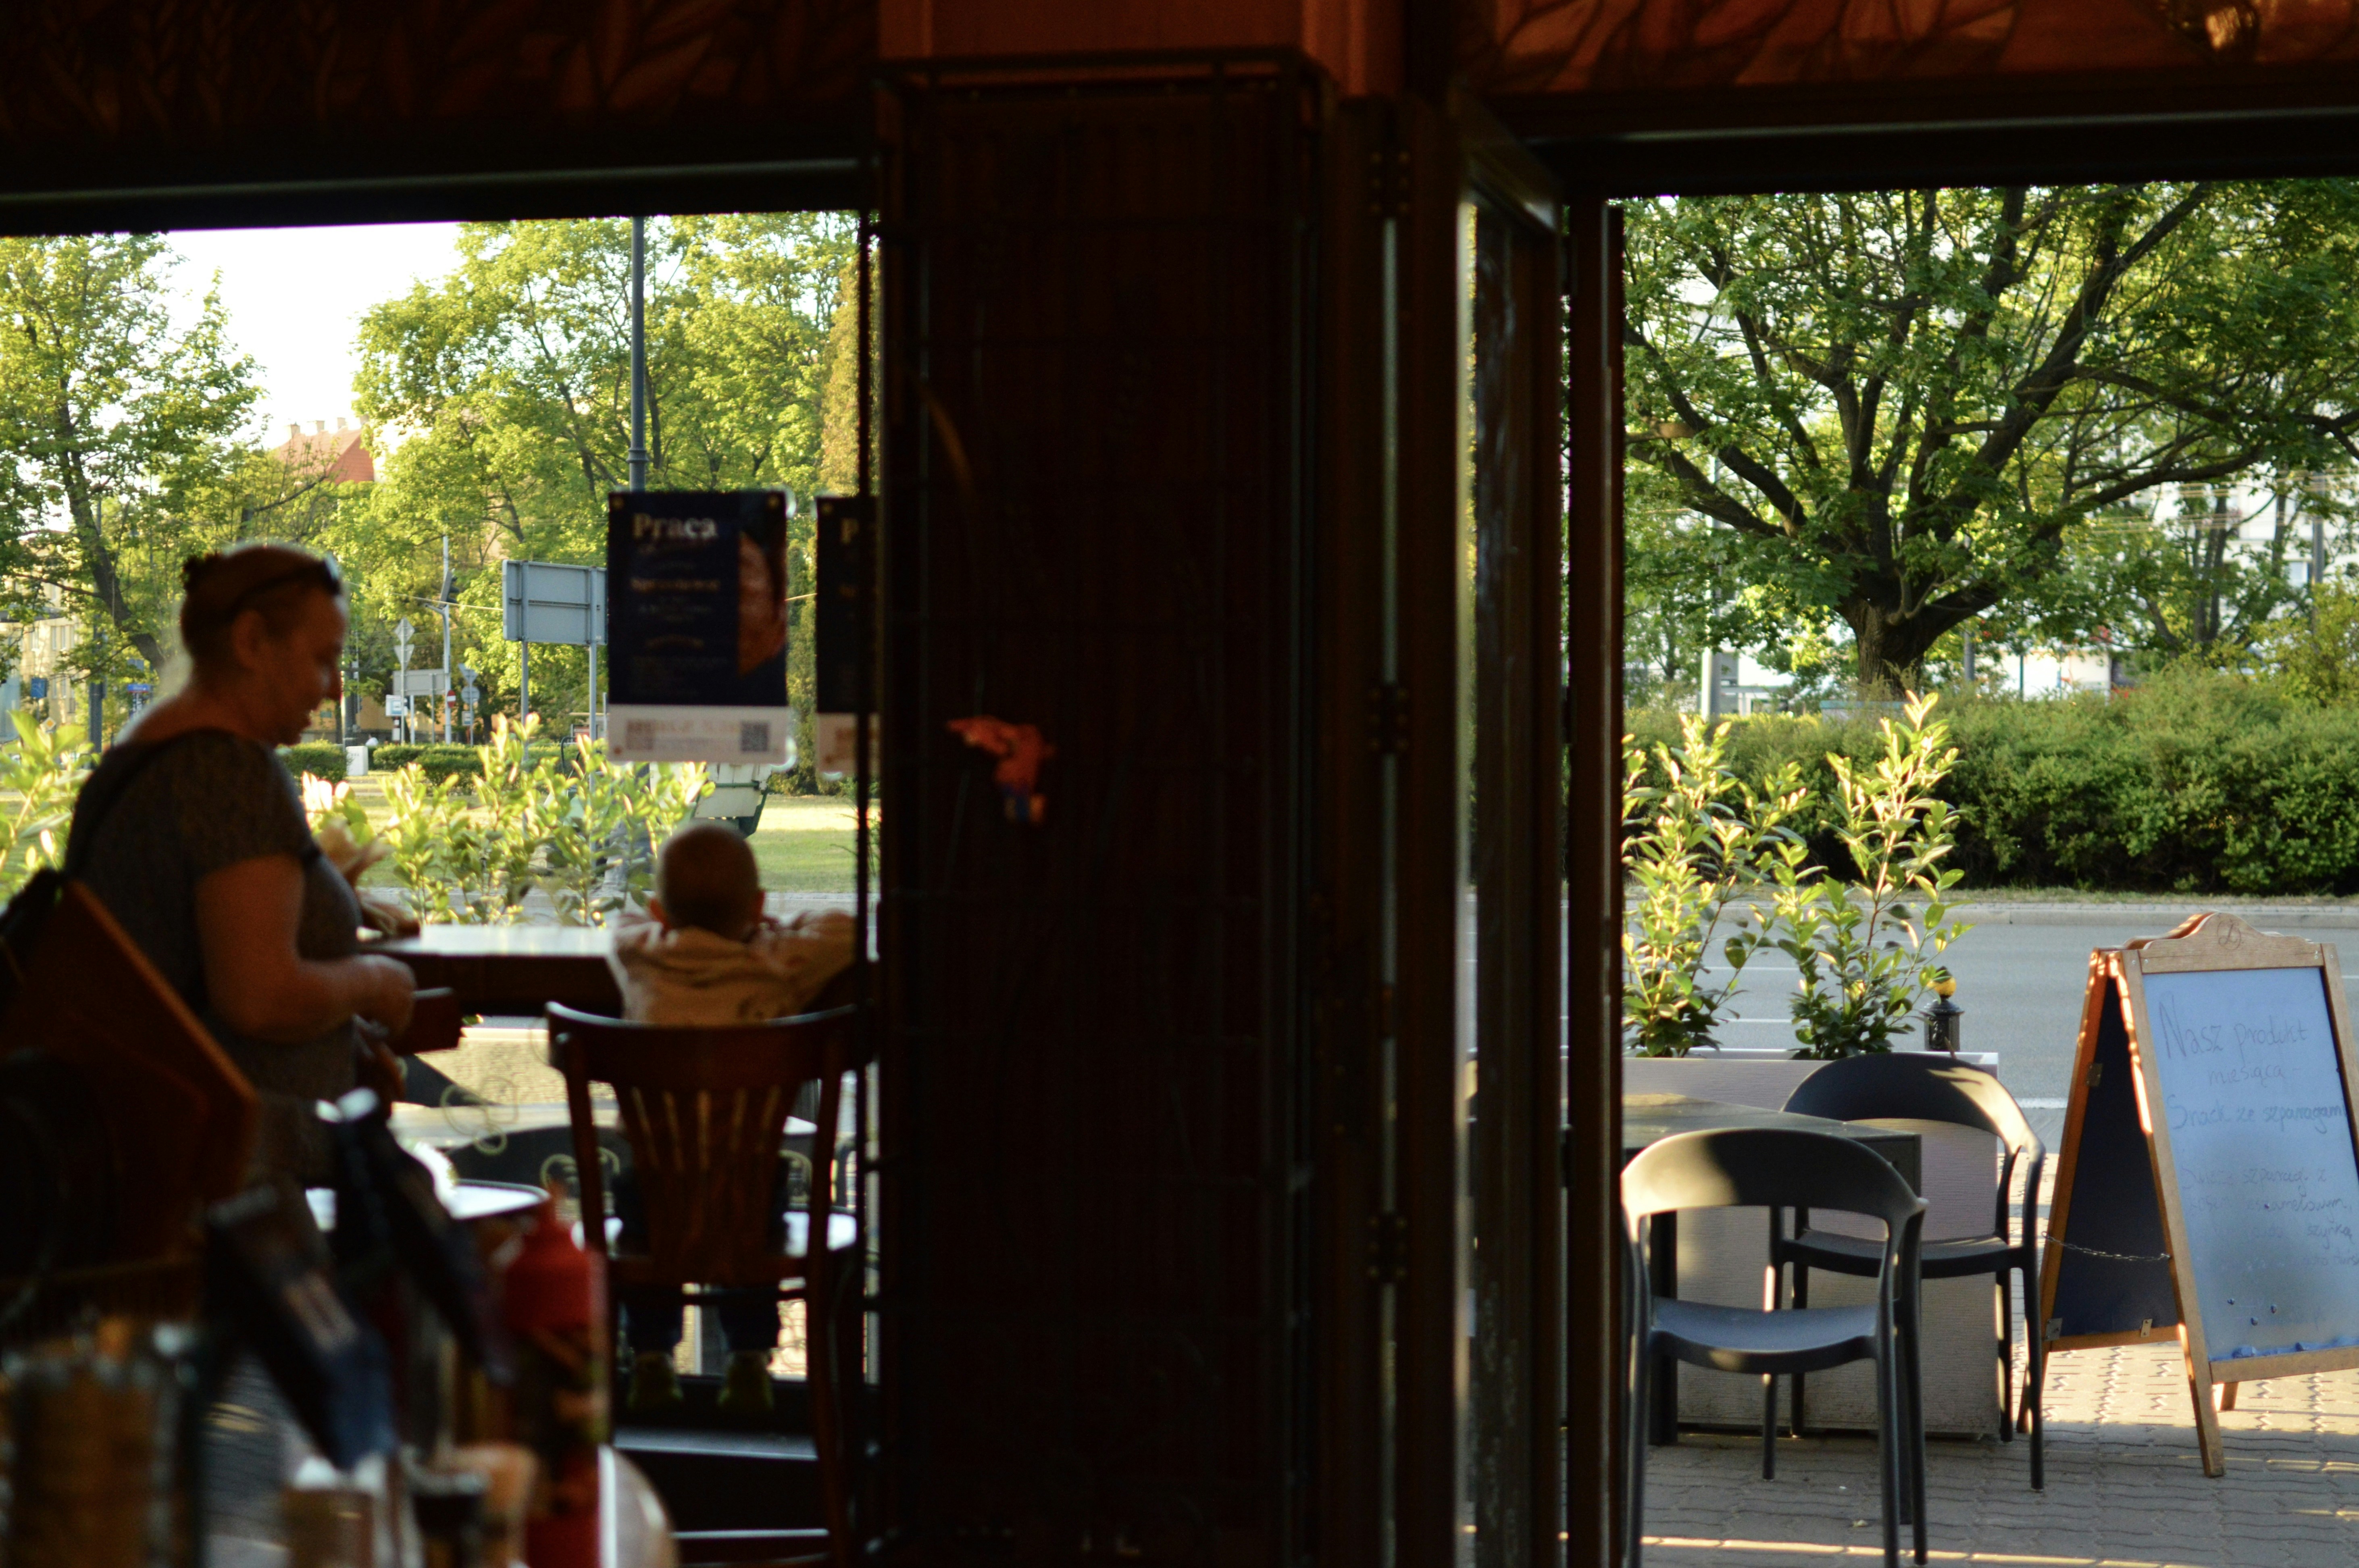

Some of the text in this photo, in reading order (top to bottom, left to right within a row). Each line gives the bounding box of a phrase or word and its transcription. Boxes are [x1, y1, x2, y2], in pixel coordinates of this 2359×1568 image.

[631, 512, 718, 539] Praca
[2159, 994, 2307, 1066] Nasz produkt
[2209, 1065, 2285, 1088] miesiąca
[2166, 1094, 2230, 1129] Snack
[2237, 1105, 2257, 1122] ze
